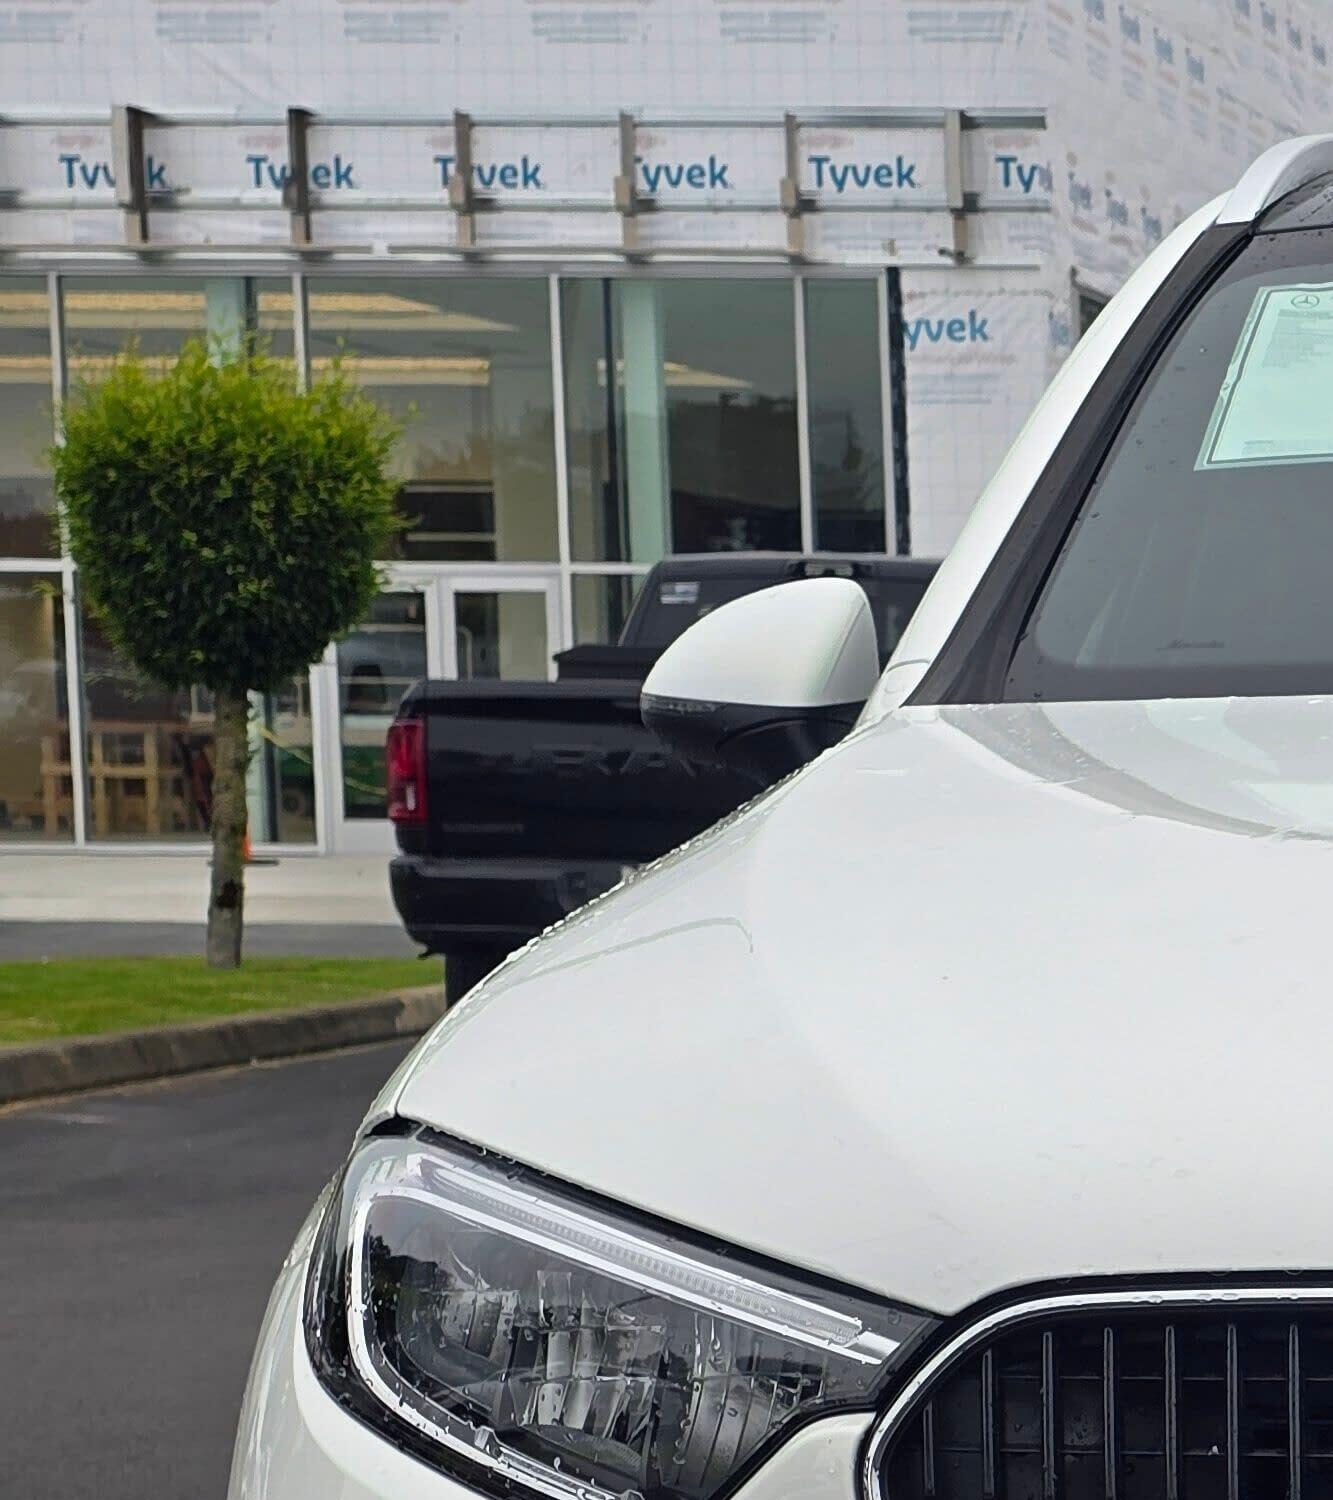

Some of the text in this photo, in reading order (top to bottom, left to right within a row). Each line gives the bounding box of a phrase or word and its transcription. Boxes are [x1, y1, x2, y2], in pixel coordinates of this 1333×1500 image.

[245, 153, 354, 190] Tyek
[434, 153, 542, 190] Tvek
[808, 155, 918, 193] Tyvek
[902, 309, 989, 351] yvek
